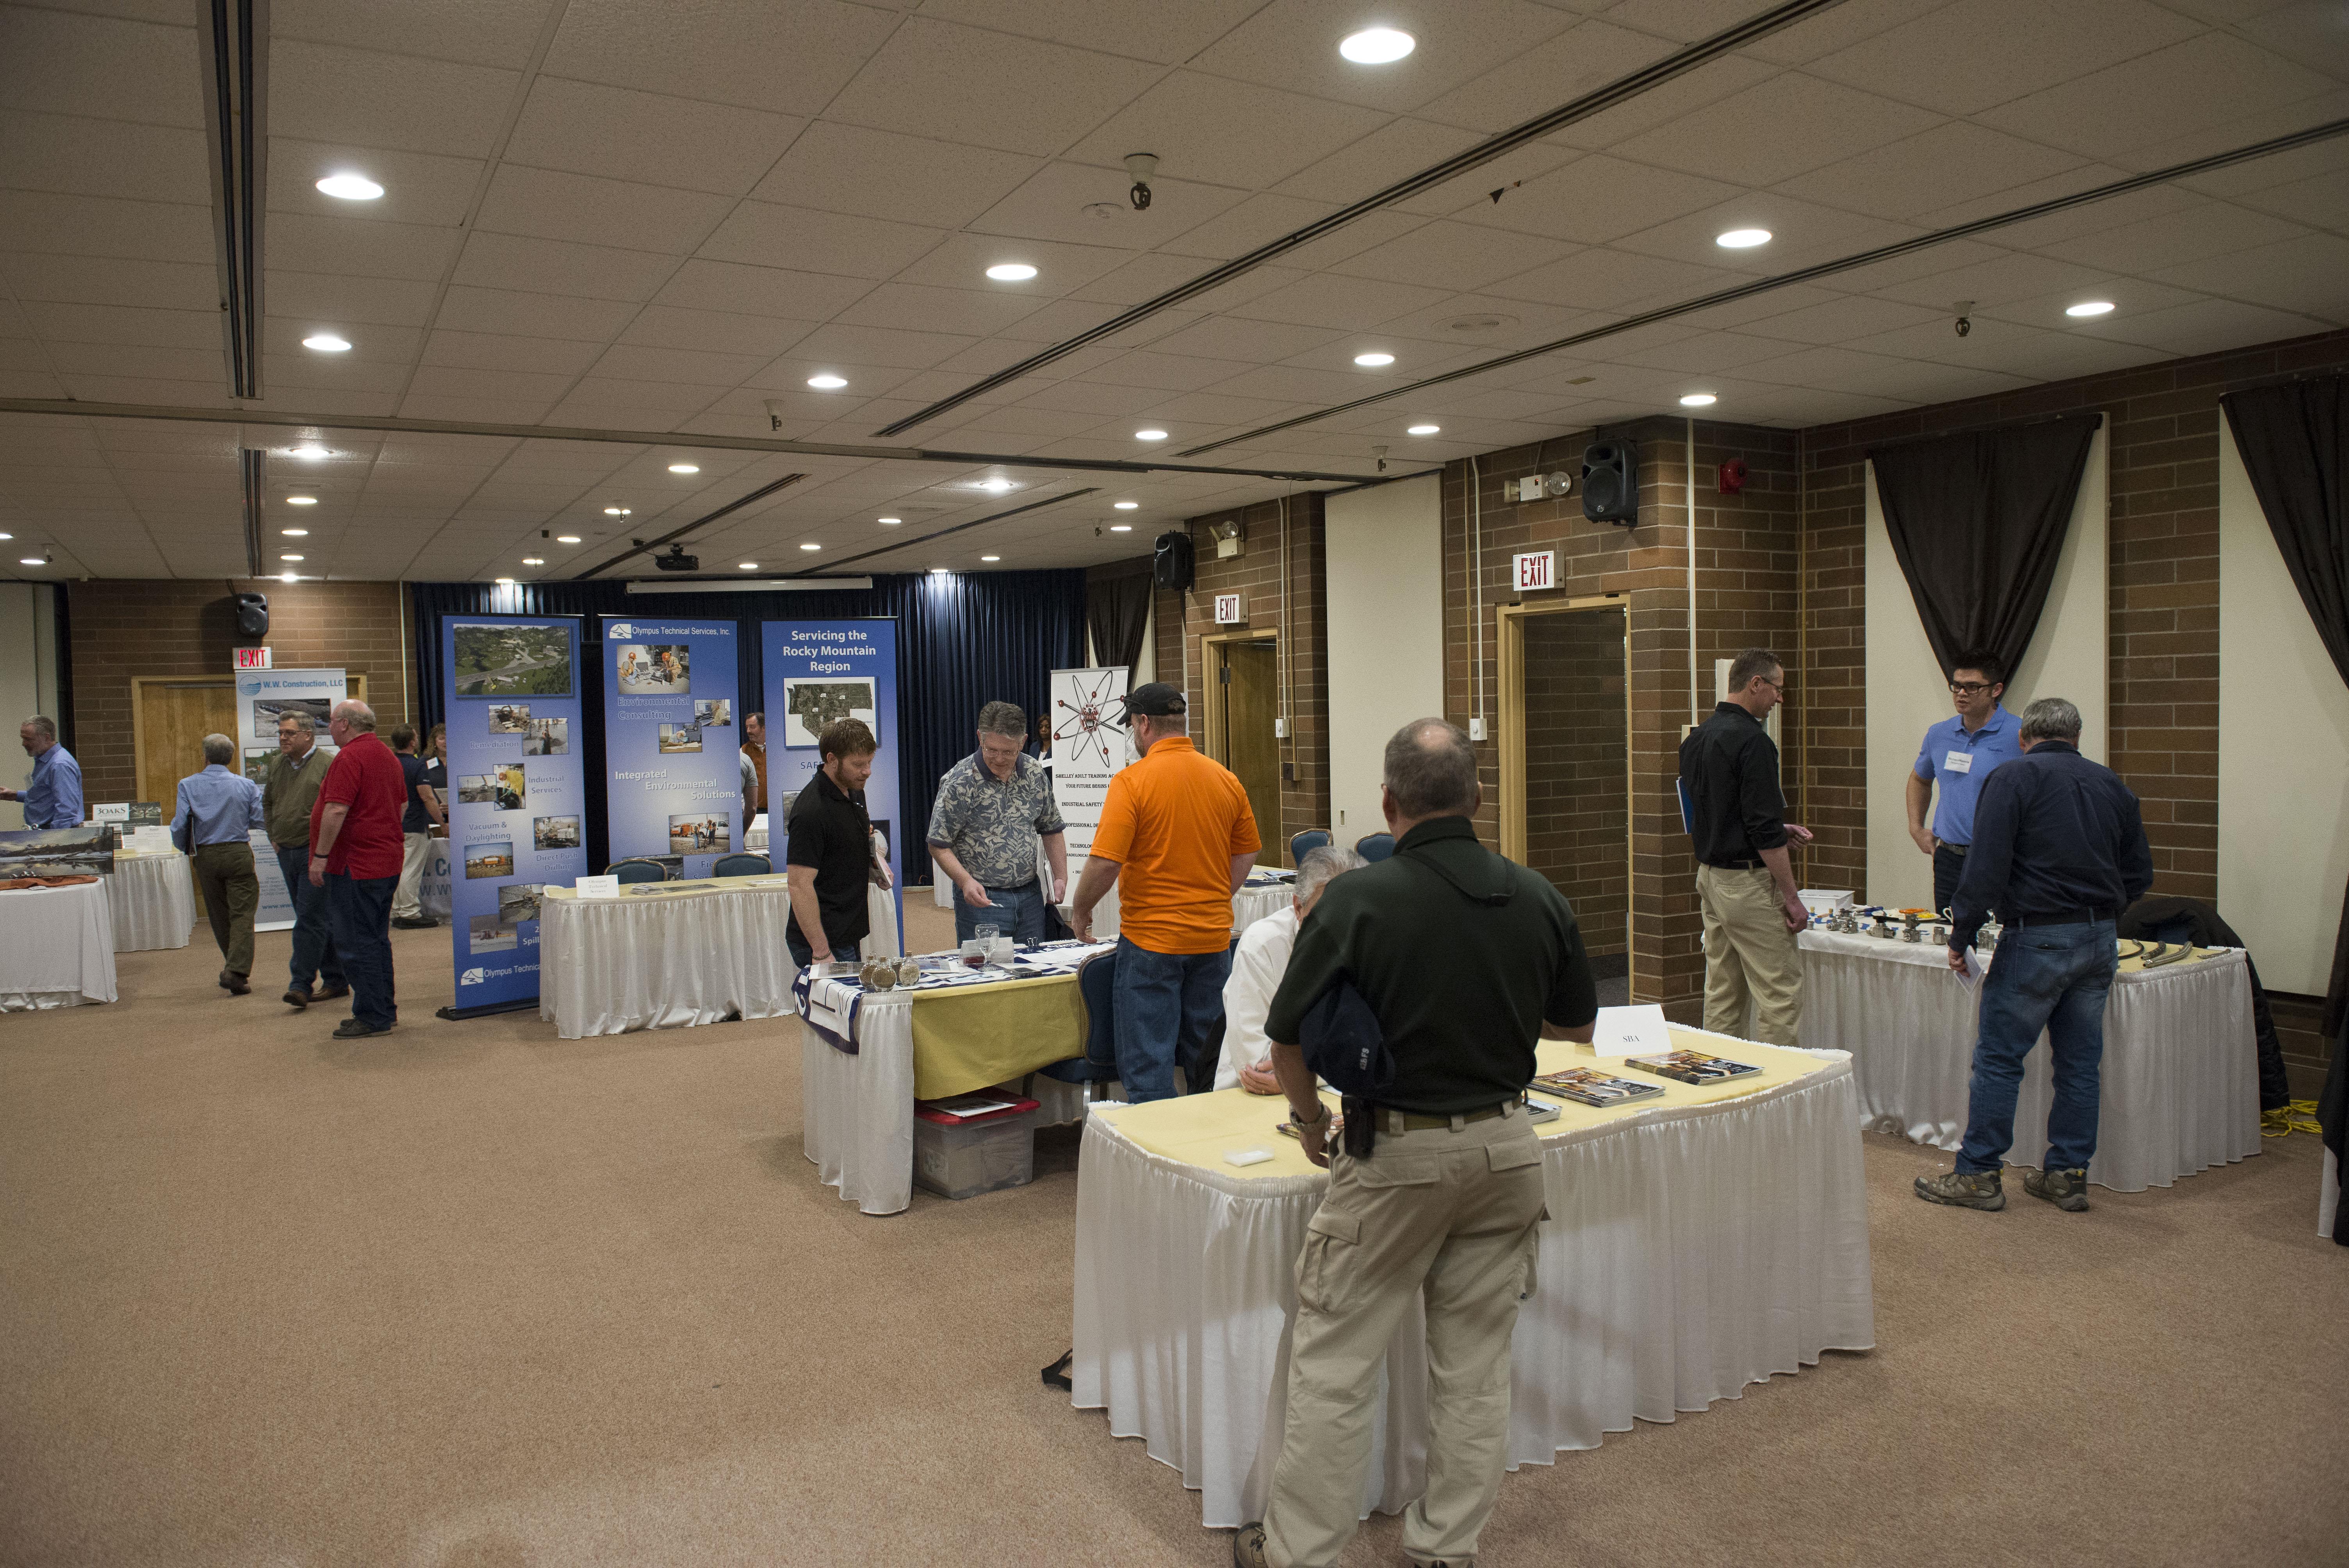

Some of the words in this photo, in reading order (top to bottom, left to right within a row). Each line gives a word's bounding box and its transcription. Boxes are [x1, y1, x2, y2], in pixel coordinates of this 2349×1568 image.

[1521, 555, 1549, 587] EXIT
[1220, 598, 1236, 620] EXIT
[632, 627, 659, 636] Olympus
[660, 627, 689, 635] Technical
[691, 627, 718, 636] Services,
[791, 630, 846, 643] Servicing
[848, 630, 867, 640] the
[783, 645, 818, 658] Rocky
[821, 645, 876, 656] Mountain
[239, 649, 266, 667] EXIT
[810, 661, 850, 674] Region
[282, 680, 329, 688] Construction,
[330, 679, 343, 687] LLC
[618, 696, 690, 706] Environmental
[618, 710, 671, 721] Consulting
[615, 769, 667, 781] Integrated
[645, 779, 718, 791] Environmental
[691, 791, 736, 800] Solutions
[465, 832, 511, 843] Daylighting
[544, 863, 572, 872] Drilling
[523, 936, 539, 946] Spill
[484, 967, 512, 978] Olympus
[513, 963, 540, 973] Technica
